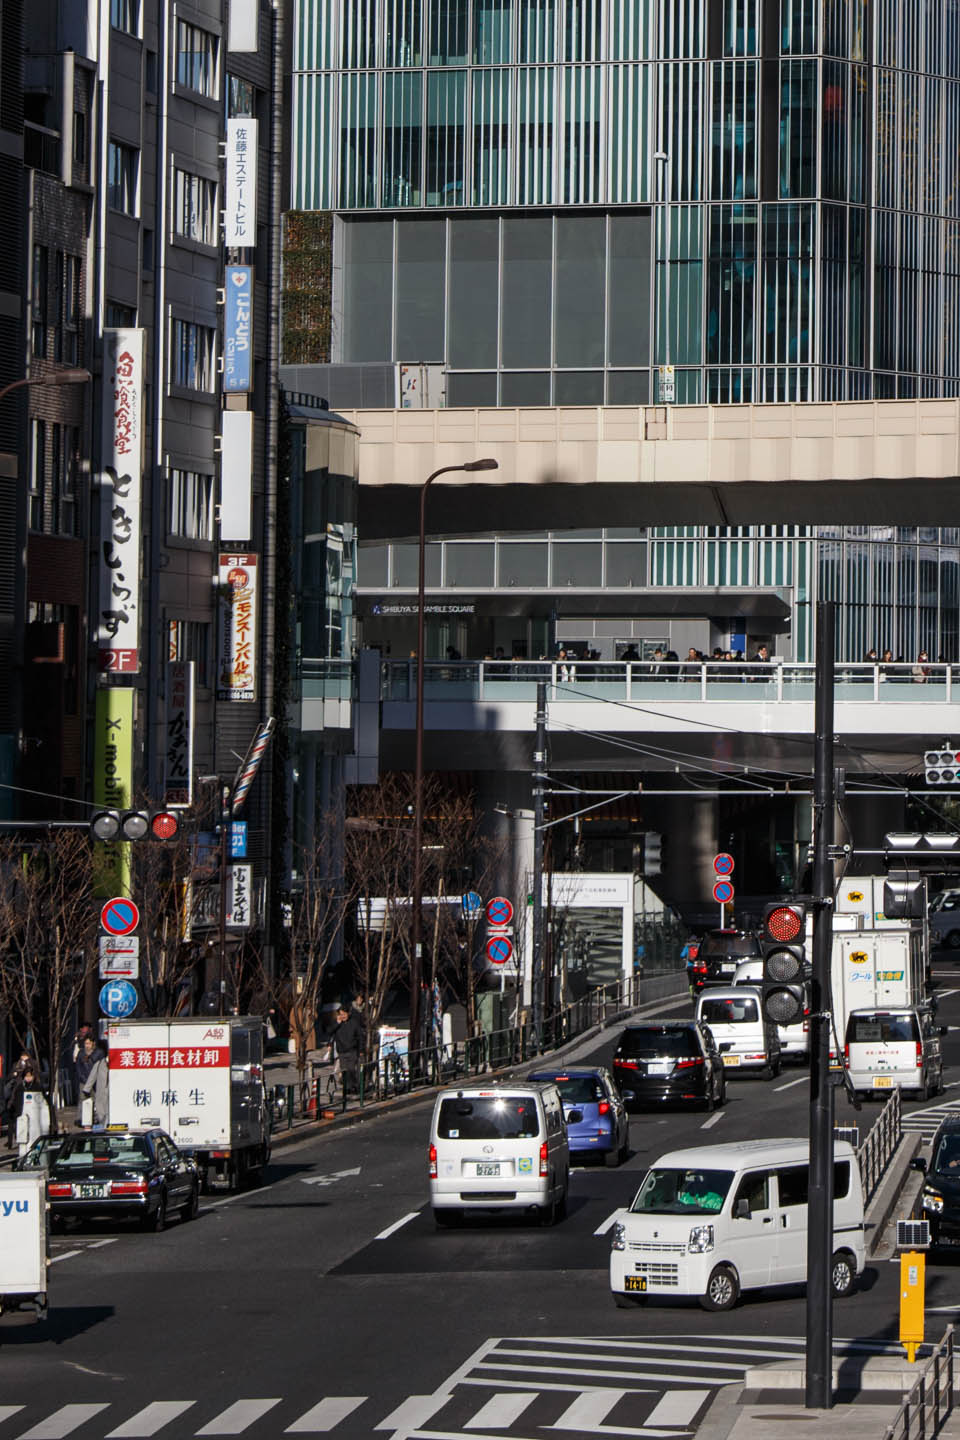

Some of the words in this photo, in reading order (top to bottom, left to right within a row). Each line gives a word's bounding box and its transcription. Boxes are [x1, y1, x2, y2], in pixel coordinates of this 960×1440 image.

[235, 292, 250, 352] こんどう
[382, 605, 411, 613] SHIBUYA
[105, 650, 132, 671] 2F
[120, 1049, 220, 1066] 業務用食材卸
[0, 1199, 29, 1216] yu
